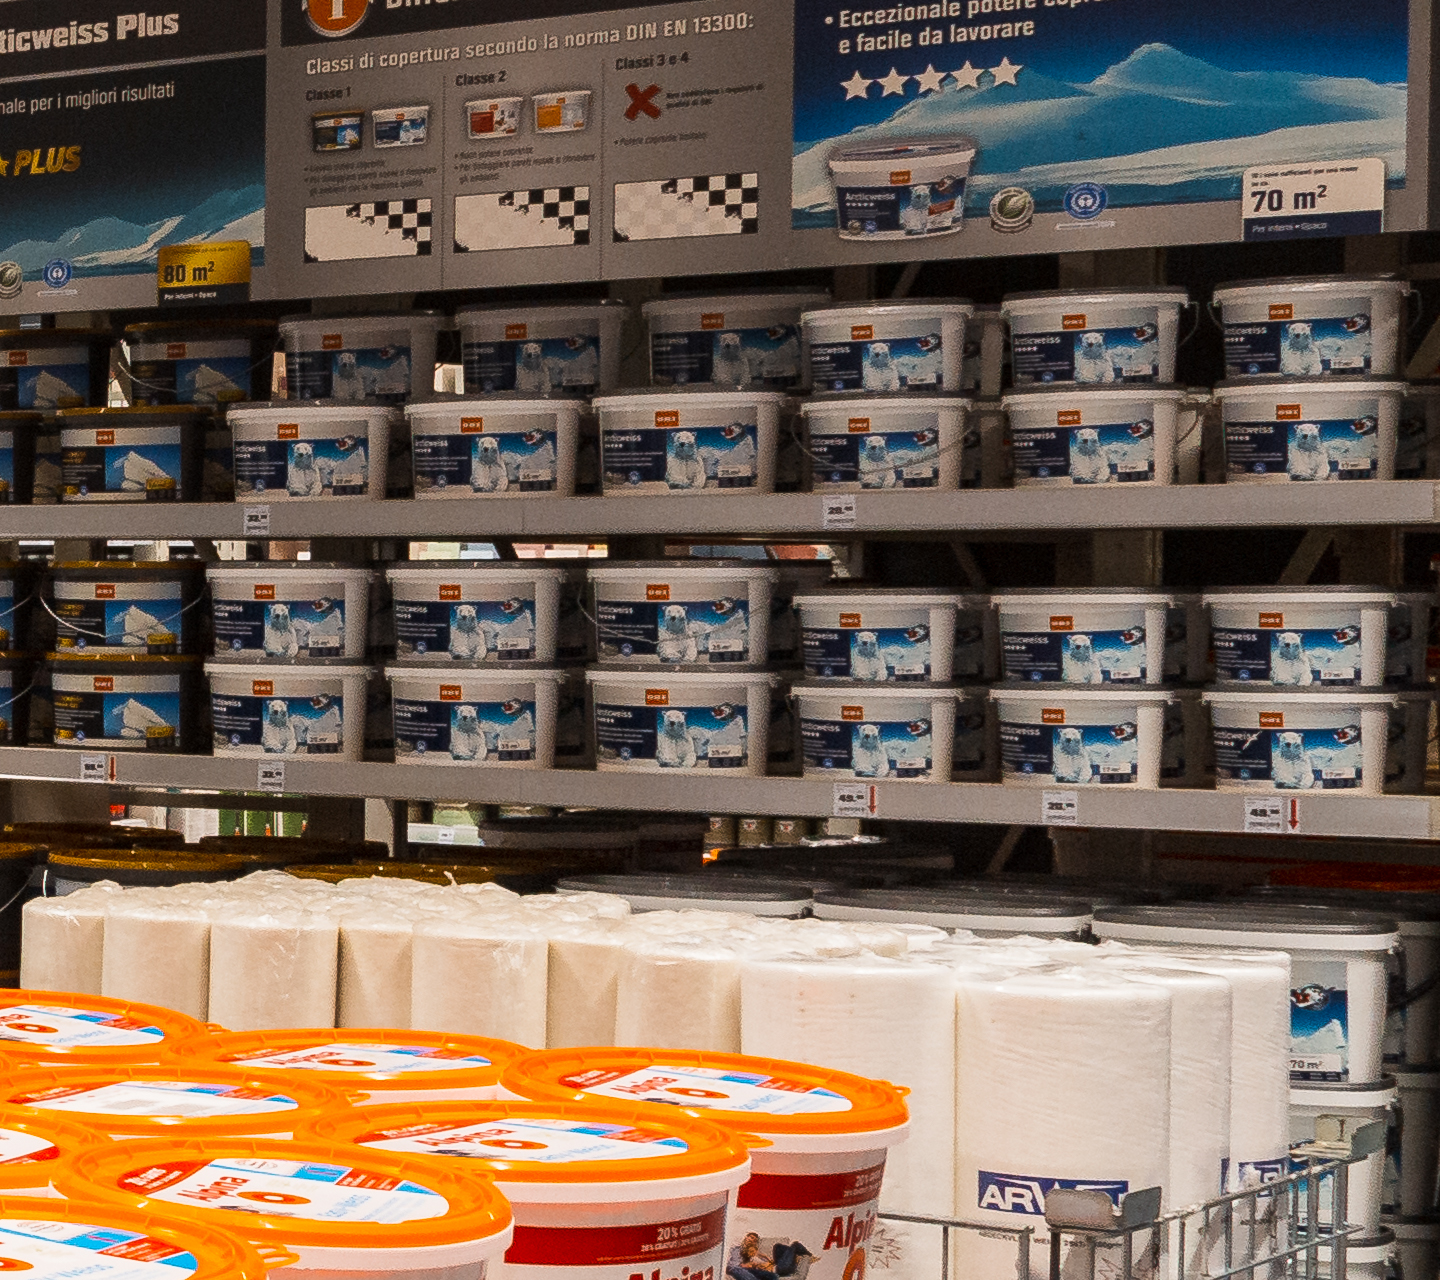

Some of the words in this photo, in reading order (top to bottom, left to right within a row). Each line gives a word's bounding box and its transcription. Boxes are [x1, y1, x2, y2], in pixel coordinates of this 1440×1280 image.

[116, 12, 180, 41] Plus
[839, 38, 850, 55] e
[856, 27, 913, 53] facile
[919, 26, 943, 46] da
[949, 18, 1035, 44] lavorare
[30, 96, 52, 116] per
[57, 92, 63, 110] i
[66, 87, 117, 114] migliori
[121, 81, 176, 102] risultati
[14, 145, 82, 176] PLUS
[1250, 188, 1283, 214] 70
[162, 261, 188, 286] 80
